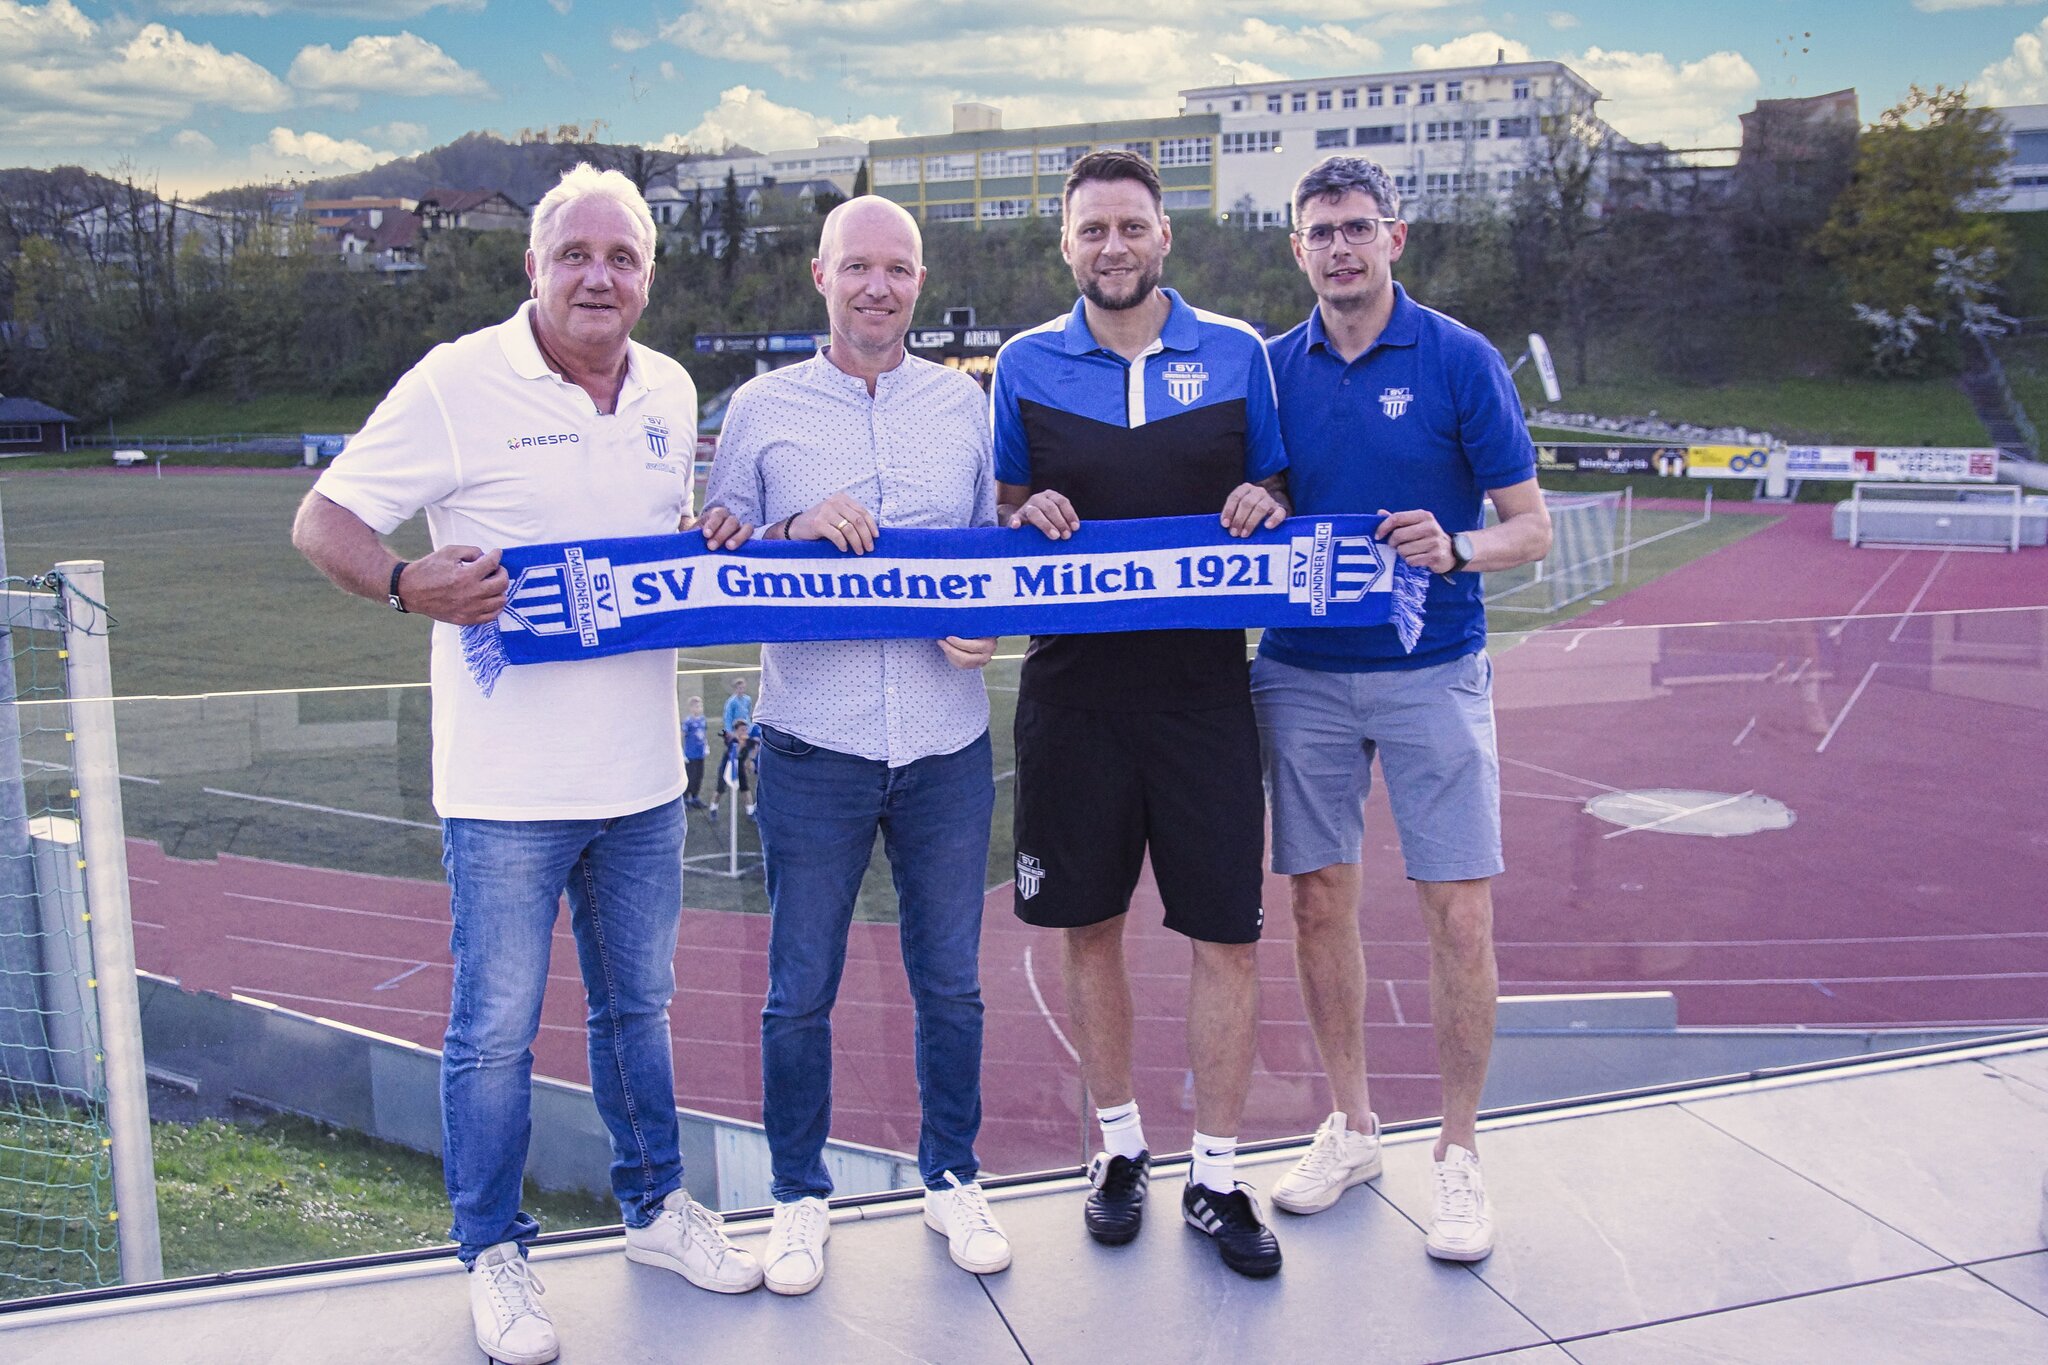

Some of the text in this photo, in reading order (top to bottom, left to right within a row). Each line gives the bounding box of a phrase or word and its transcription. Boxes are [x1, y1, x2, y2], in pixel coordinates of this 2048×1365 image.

[963, 330, 1002, 347] ARENA
[1175, 364, 1196, 372] SV
[647, 417, 661, 425] SV
[521, 433, 580, 447] RIESPO
[632, 554, 1273, 606] SV Gmundner Milch 1921
[1293, 551, 1308, 588] SV
[1312, 524, 1330, 615] GMUNDNER MILCH
[567, 549, 597, 646] GMUNDNER MILCH
[593, 573, 614, 612] SV
